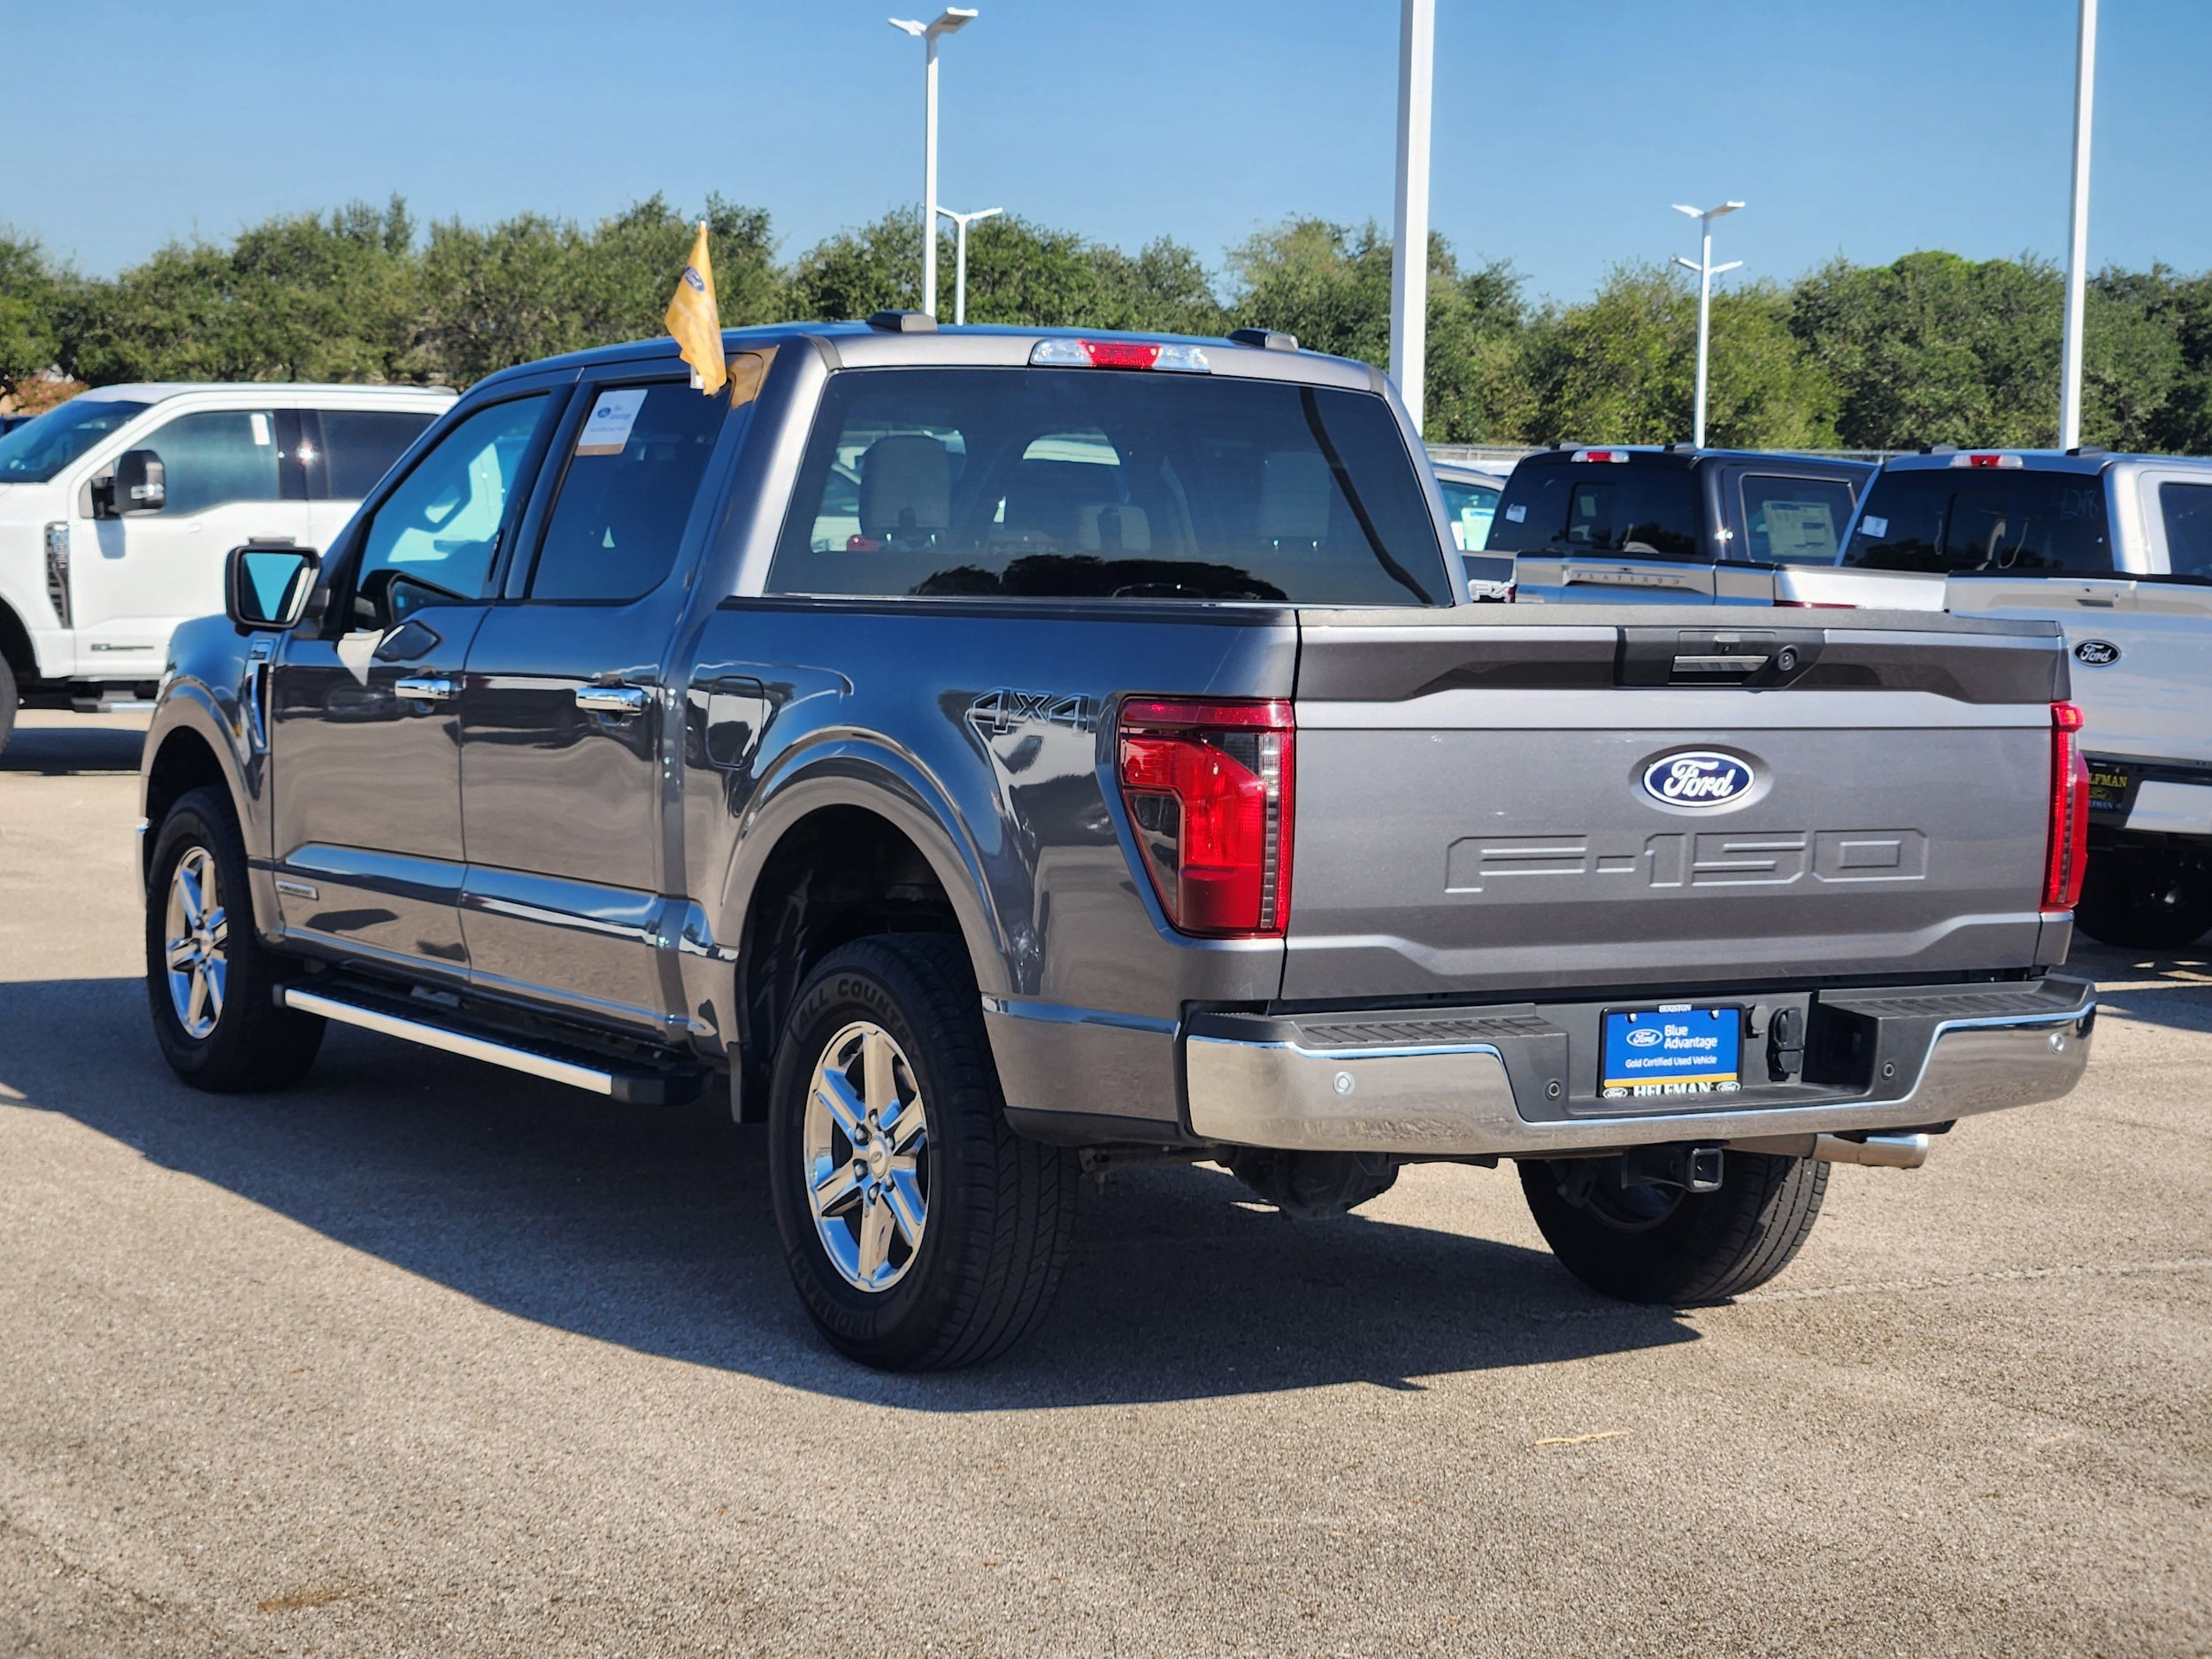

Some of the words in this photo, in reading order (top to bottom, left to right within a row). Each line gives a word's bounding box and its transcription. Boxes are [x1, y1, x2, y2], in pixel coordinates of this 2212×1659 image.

[2079, 643, 2113, 663] Ford
[1663, 758, 1735, 799] Ford
[2089, 772, 2128, 787] LFMAN
[1445, 828, 1927, 893] F-150
[837, 979, 920, 1062] COUNTRY
[1664, 1024, 1689, 1036] Blue
[1663, 1036, 1718, 1050] Advantage
[1624, 1058, 1642, 1069] Gold
[1642, 1056, 1673, 1068] Certified
[1673, 1055, 1692, 1066] Used
[1692, 1054, 1717, 1065] Vehicle
